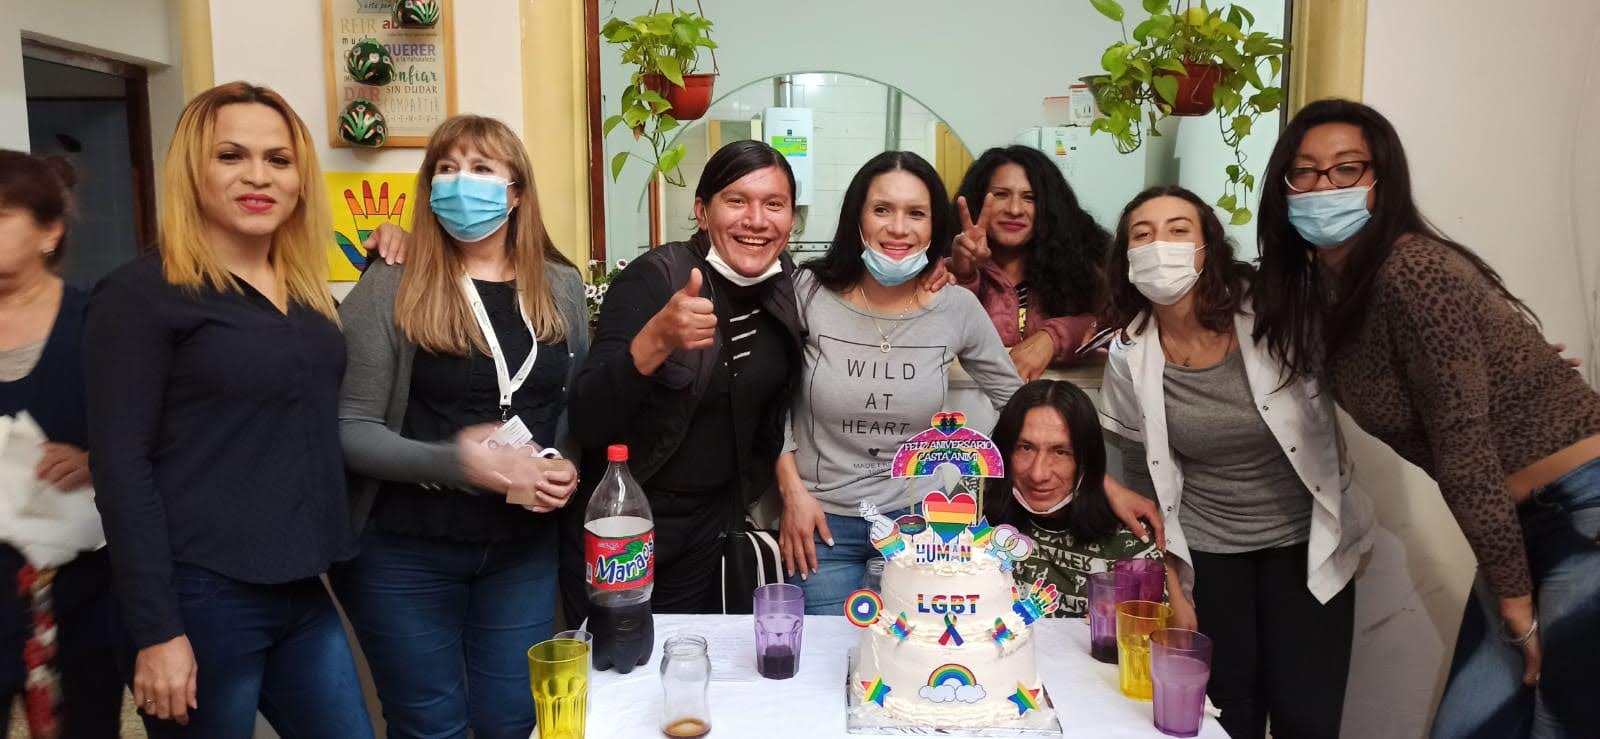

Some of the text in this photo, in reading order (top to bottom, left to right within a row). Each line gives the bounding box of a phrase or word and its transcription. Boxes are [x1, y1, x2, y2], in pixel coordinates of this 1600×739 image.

[385, 86, 438, 94] SIN DUDAR
[847, 358, 916, 380] WILD
[865, 393, 894, 410] AT
[842, 419, 911, 436] HEART
[904, 440, 994, 451] FELIZ ANIVERSARIO
[918, 452, 948, 461] CASTA
[916, 543, 971, 563] HUMAN
[917, 593, 980, 614] LGBT
